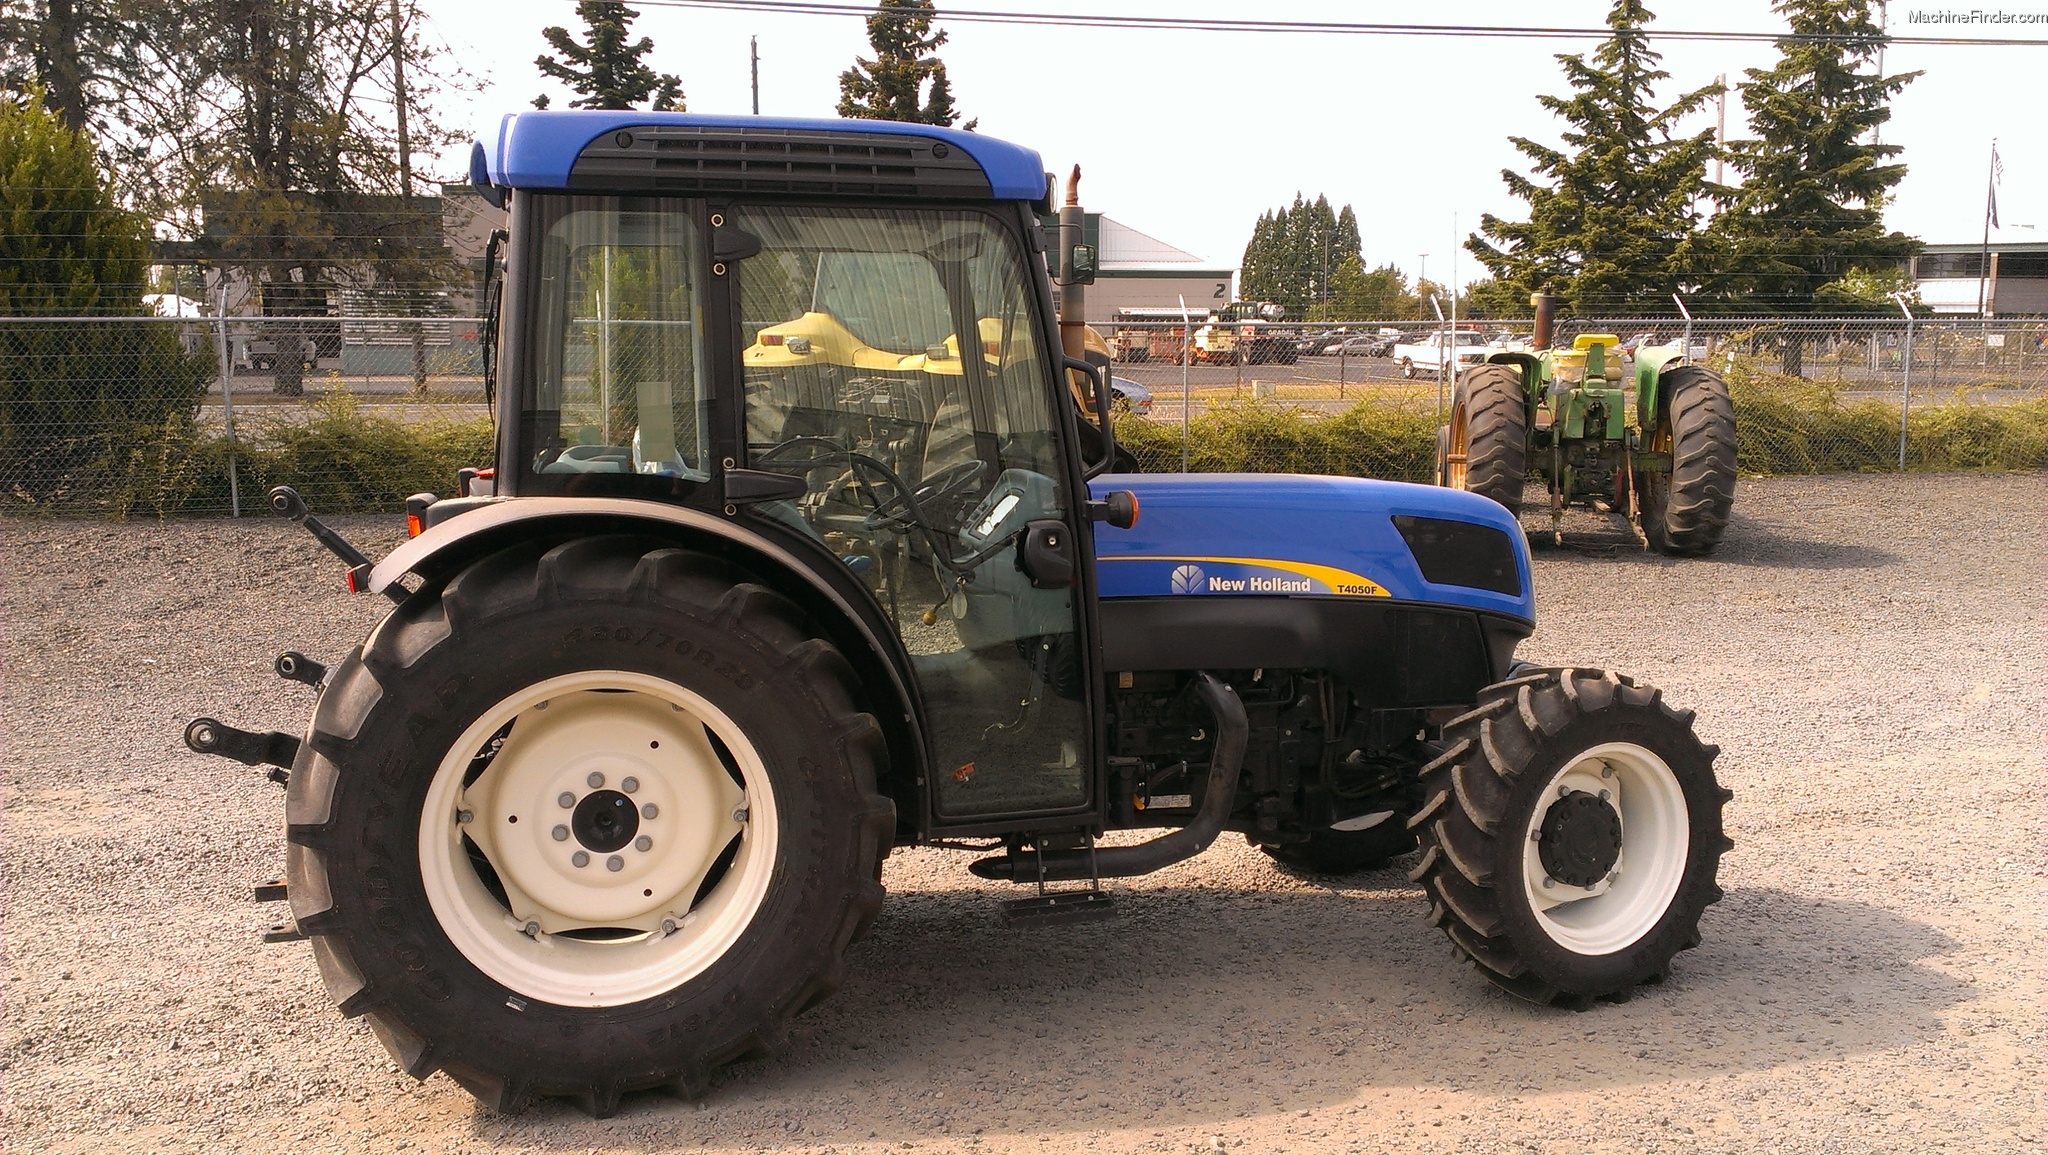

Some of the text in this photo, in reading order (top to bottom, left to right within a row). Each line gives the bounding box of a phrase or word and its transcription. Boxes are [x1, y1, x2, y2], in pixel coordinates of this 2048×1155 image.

[1213, 283, 1226, 298] 2
[1209, 576, 1311, 592] New Holland
[1337, 584, 1377, 595] T4050F
